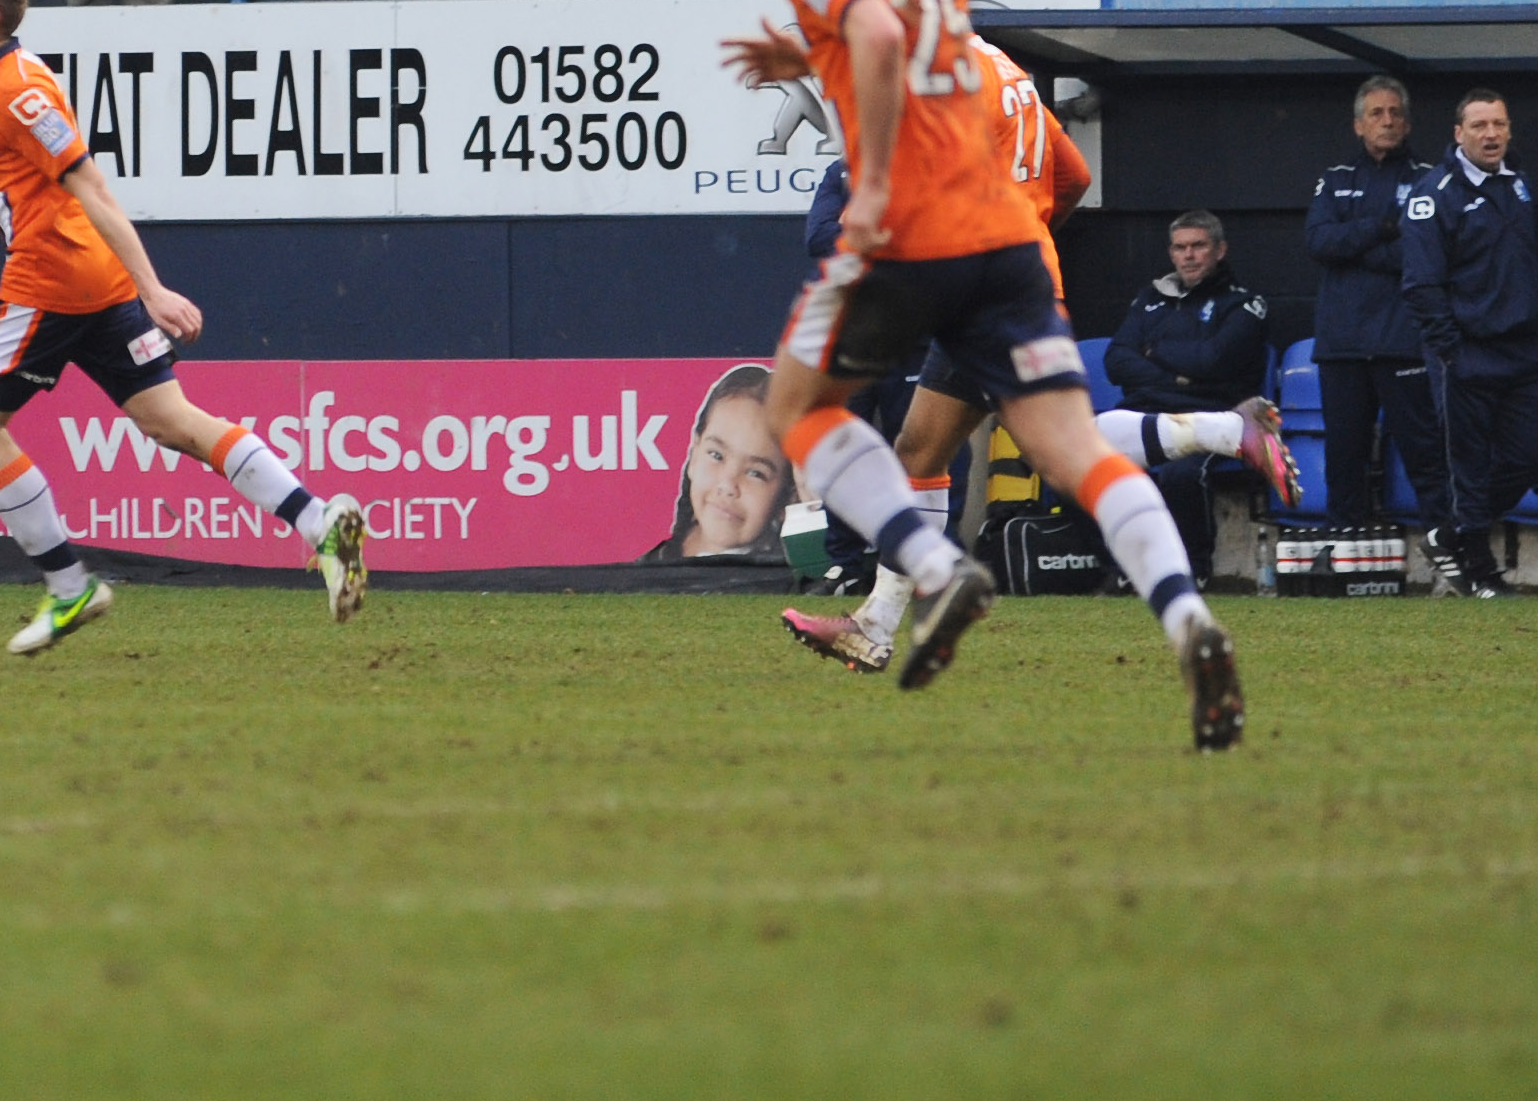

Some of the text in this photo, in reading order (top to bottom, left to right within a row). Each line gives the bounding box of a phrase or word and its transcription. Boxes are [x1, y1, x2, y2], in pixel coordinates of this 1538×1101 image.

[493, 43, 661, 105] 01582
[35, 52, 154, 178] IAT
[180, 47, 430, 178] DEALER
[463, 110, 688, 173] 443500
[1001, 78, 1046, 183] 27
[693, 168, 818, 195] PEUG
